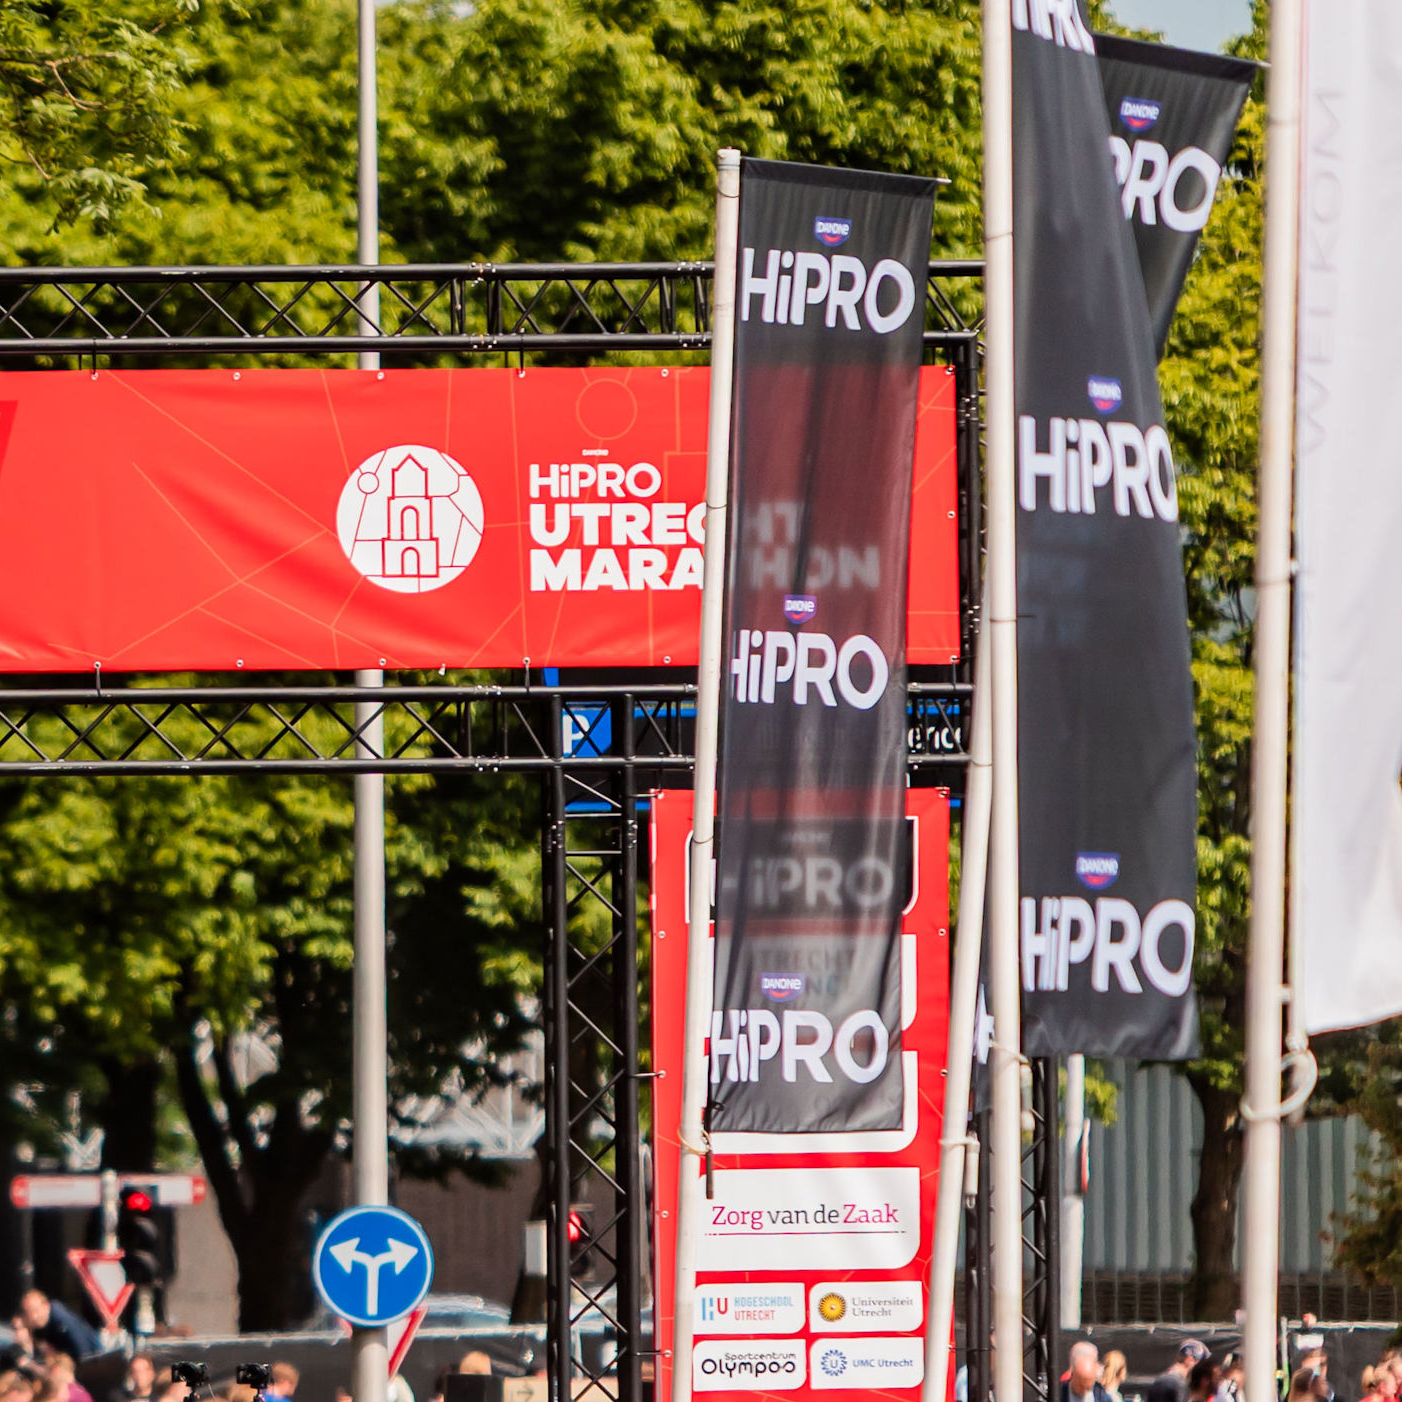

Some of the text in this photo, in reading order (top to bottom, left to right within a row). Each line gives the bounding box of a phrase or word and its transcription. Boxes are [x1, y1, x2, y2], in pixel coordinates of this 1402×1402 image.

[741, 247, 916, 334] HiPRO
[529, 462, 662, 498] HiPRO
[1019, 415, 1179, 523] HiPRO
[731, 630, 889, 710] HiPRO
[1020, 896, 1196, 998] HiPRO
[710, 1009, 889, 1085] HiPRO
[712, 1205, 764, 1230] Zorg
[843, 1203, 899, 1225] Zaak
[734, 1296, 794, 1307] HOGESCHOOL
[851, 1296, 914, 1307] Universiteit
[851, 1307, 893, 1318] Utrecht
[734, 1309, 775, 1321] UTRECHT
[701, 1358, 796, 1378] Olympos
[725, 1352, 796, 1361] Sportcentrum
[852, 1357, 914, 1368] UMC Utrecht
